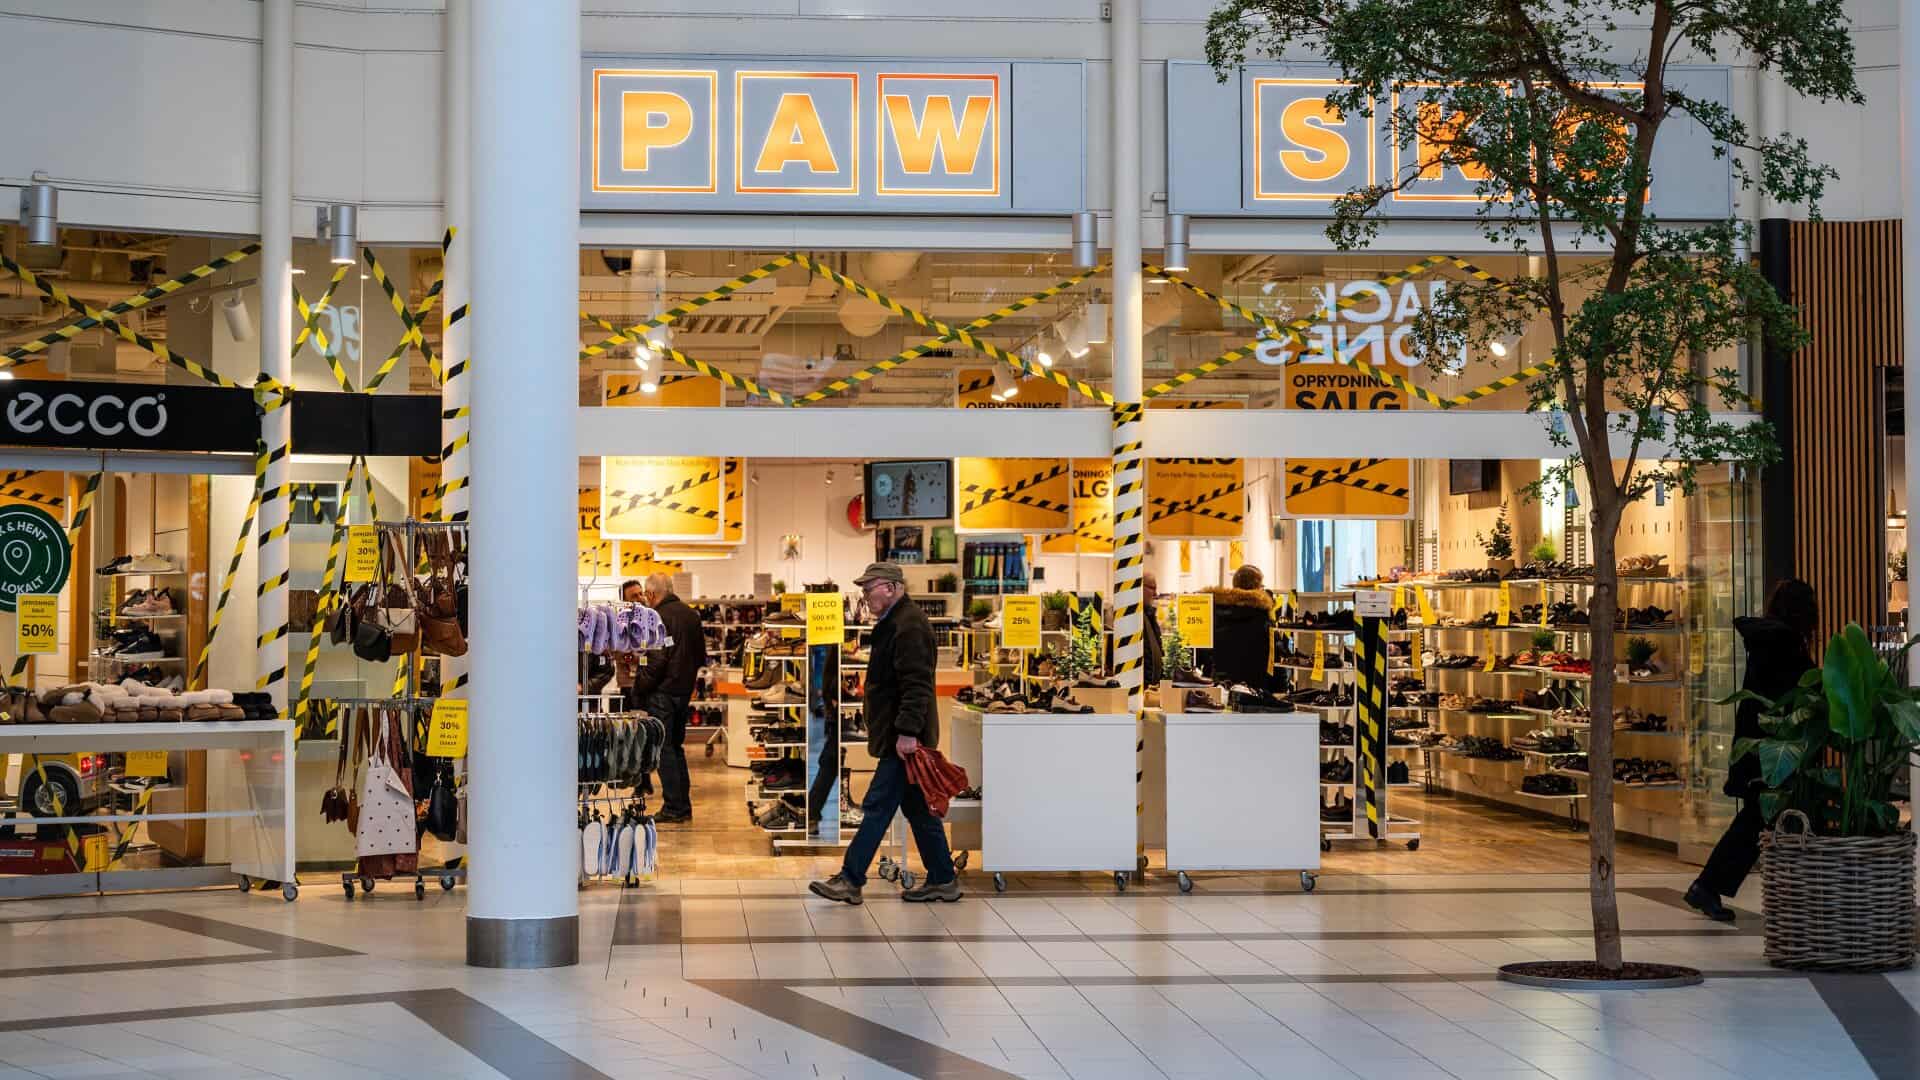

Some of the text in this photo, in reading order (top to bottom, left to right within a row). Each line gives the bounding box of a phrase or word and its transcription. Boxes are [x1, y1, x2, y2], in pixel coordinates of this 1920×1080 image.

[621, 91, 1630, 182] PAW SKO
[1292, 374, 1401, 389] OPRYDNIN
[7, 391, 168, 437] ecco
[17, 521, 48, 541] HENT
[1, 575, 44, 595] LOKALT
[812, 600, 837, 608] ECCO
[21, 623, 54, 637] 50%
[440, 720, 460, 730] 30%
